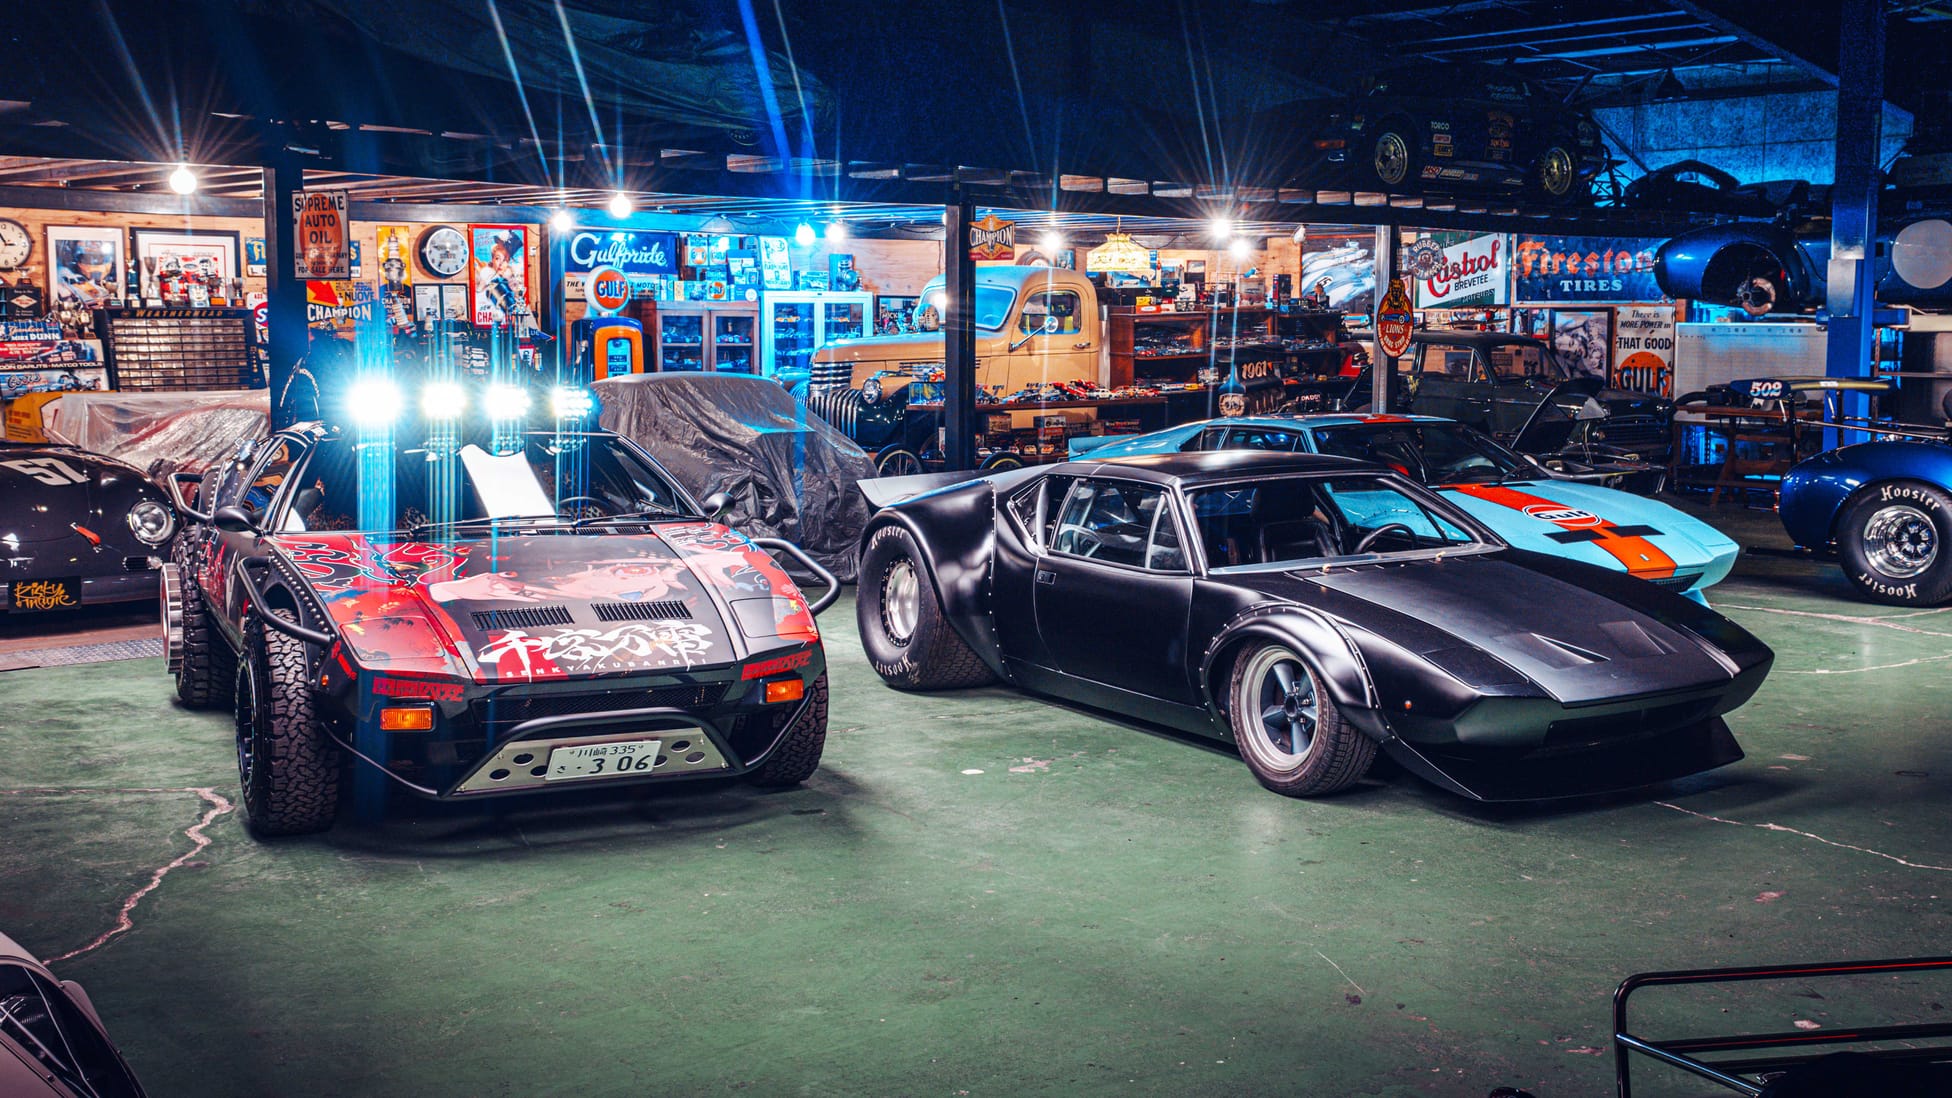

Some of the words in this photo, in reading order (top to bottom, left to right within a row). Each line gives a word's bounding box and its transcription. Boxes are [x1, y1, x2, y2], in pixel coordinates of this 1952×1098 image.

[1430, 121, 1450, 131] TORCO
[304, 214, 336, 228] AUTO
[309, 230, 333, 244] OIL
[969, 225, 1013, 247] CHAMPION
[570, 232, 668, 269] Gulfpride
[1517, 240, 1653, 278] Fireston
[596, 280, 628, 298] GULF
[1560, 280, 1623, 292] TIRES
[135, 310, 224, 318] WEATHERHEAD
[307, 303, 372, 322] CHAMPION
[1653, 310, 1661, 318] is
[1619, 320, 1640, 329] MORE
[1640, 320, 1664, 329] POWER
[1618, 336, 1641, 350] THAT
[1644, 337, 1672, 350] GOOD
[1241, 360, 1267, 379] 1961
[1620, 366, 1667, 394] GULF
[1749, 381, 1783, 397] 502
[0, 457, 91, 486] 57
[1881, 484, 1941, 510] Hoosier
[1533, 510, 1590, 520] Gulf
[871, 526, 905, 550] Hoosier
[1858, 572, 1917, 600] Hoosier
[577, 747, 608, 757] 川崎
[608, 745, 636, 755] 335
